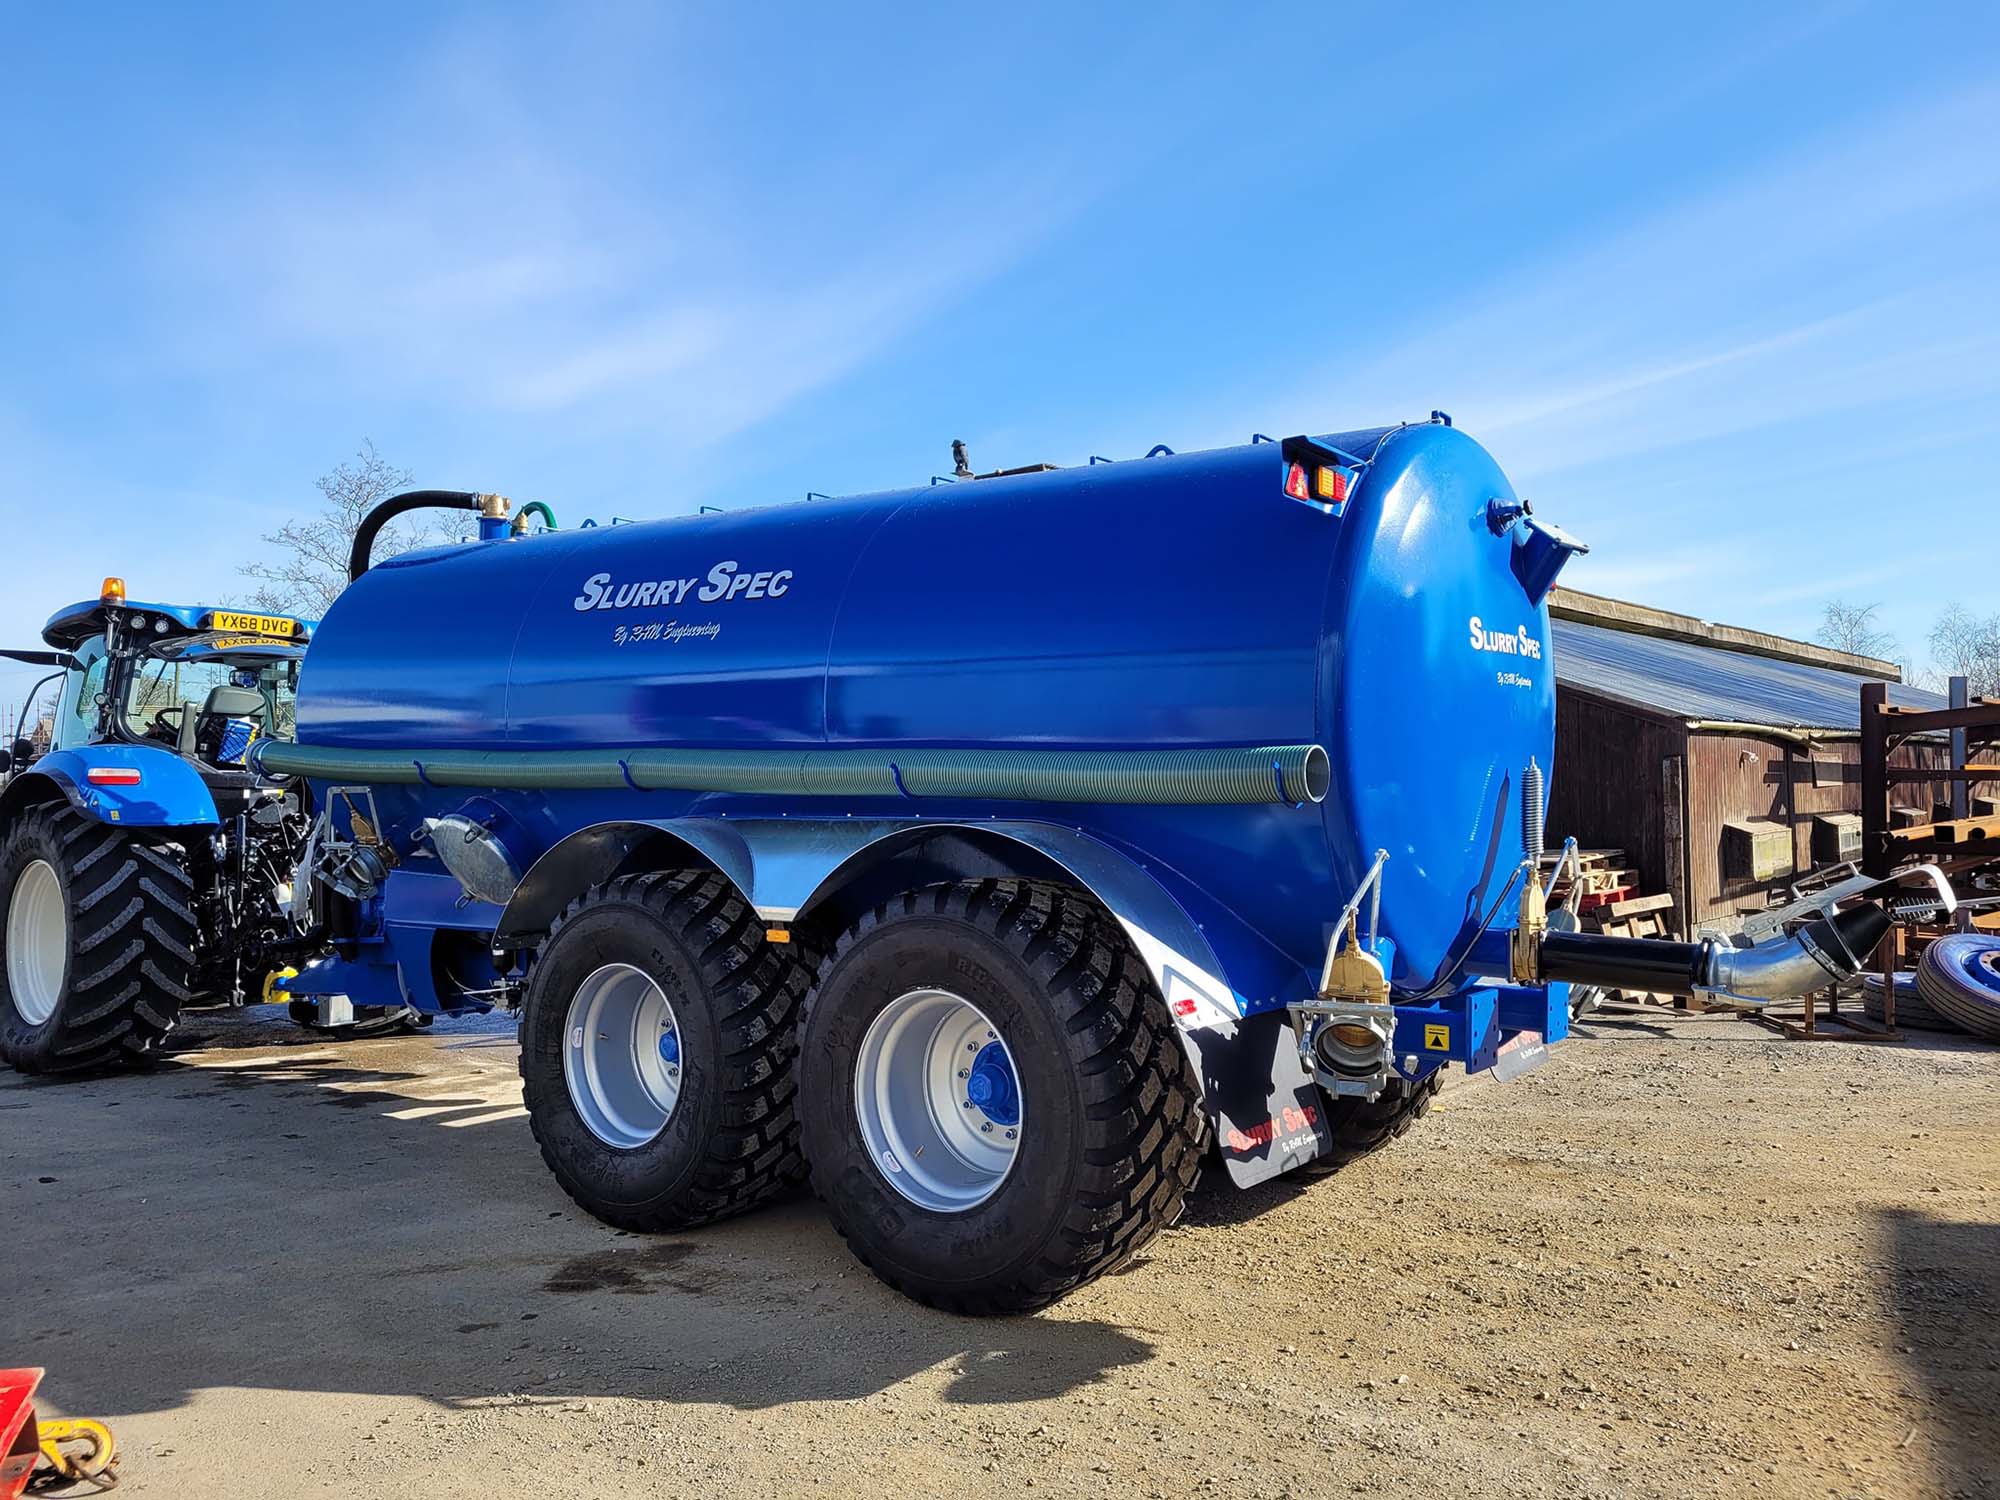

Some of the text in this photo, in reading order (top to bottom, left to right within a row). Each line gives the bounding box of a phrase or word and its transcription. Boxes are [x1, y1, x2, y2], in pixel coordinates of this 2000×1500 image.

[574, 561, 793, 611] SLURRY SPEC
[221, 615, 288, 633] YX68 DVG
[613, 624, 629, 647] By
[663, 620, 721, 644] Engineering
[1469, 616, 1541, 660] SLURRY SPEC
